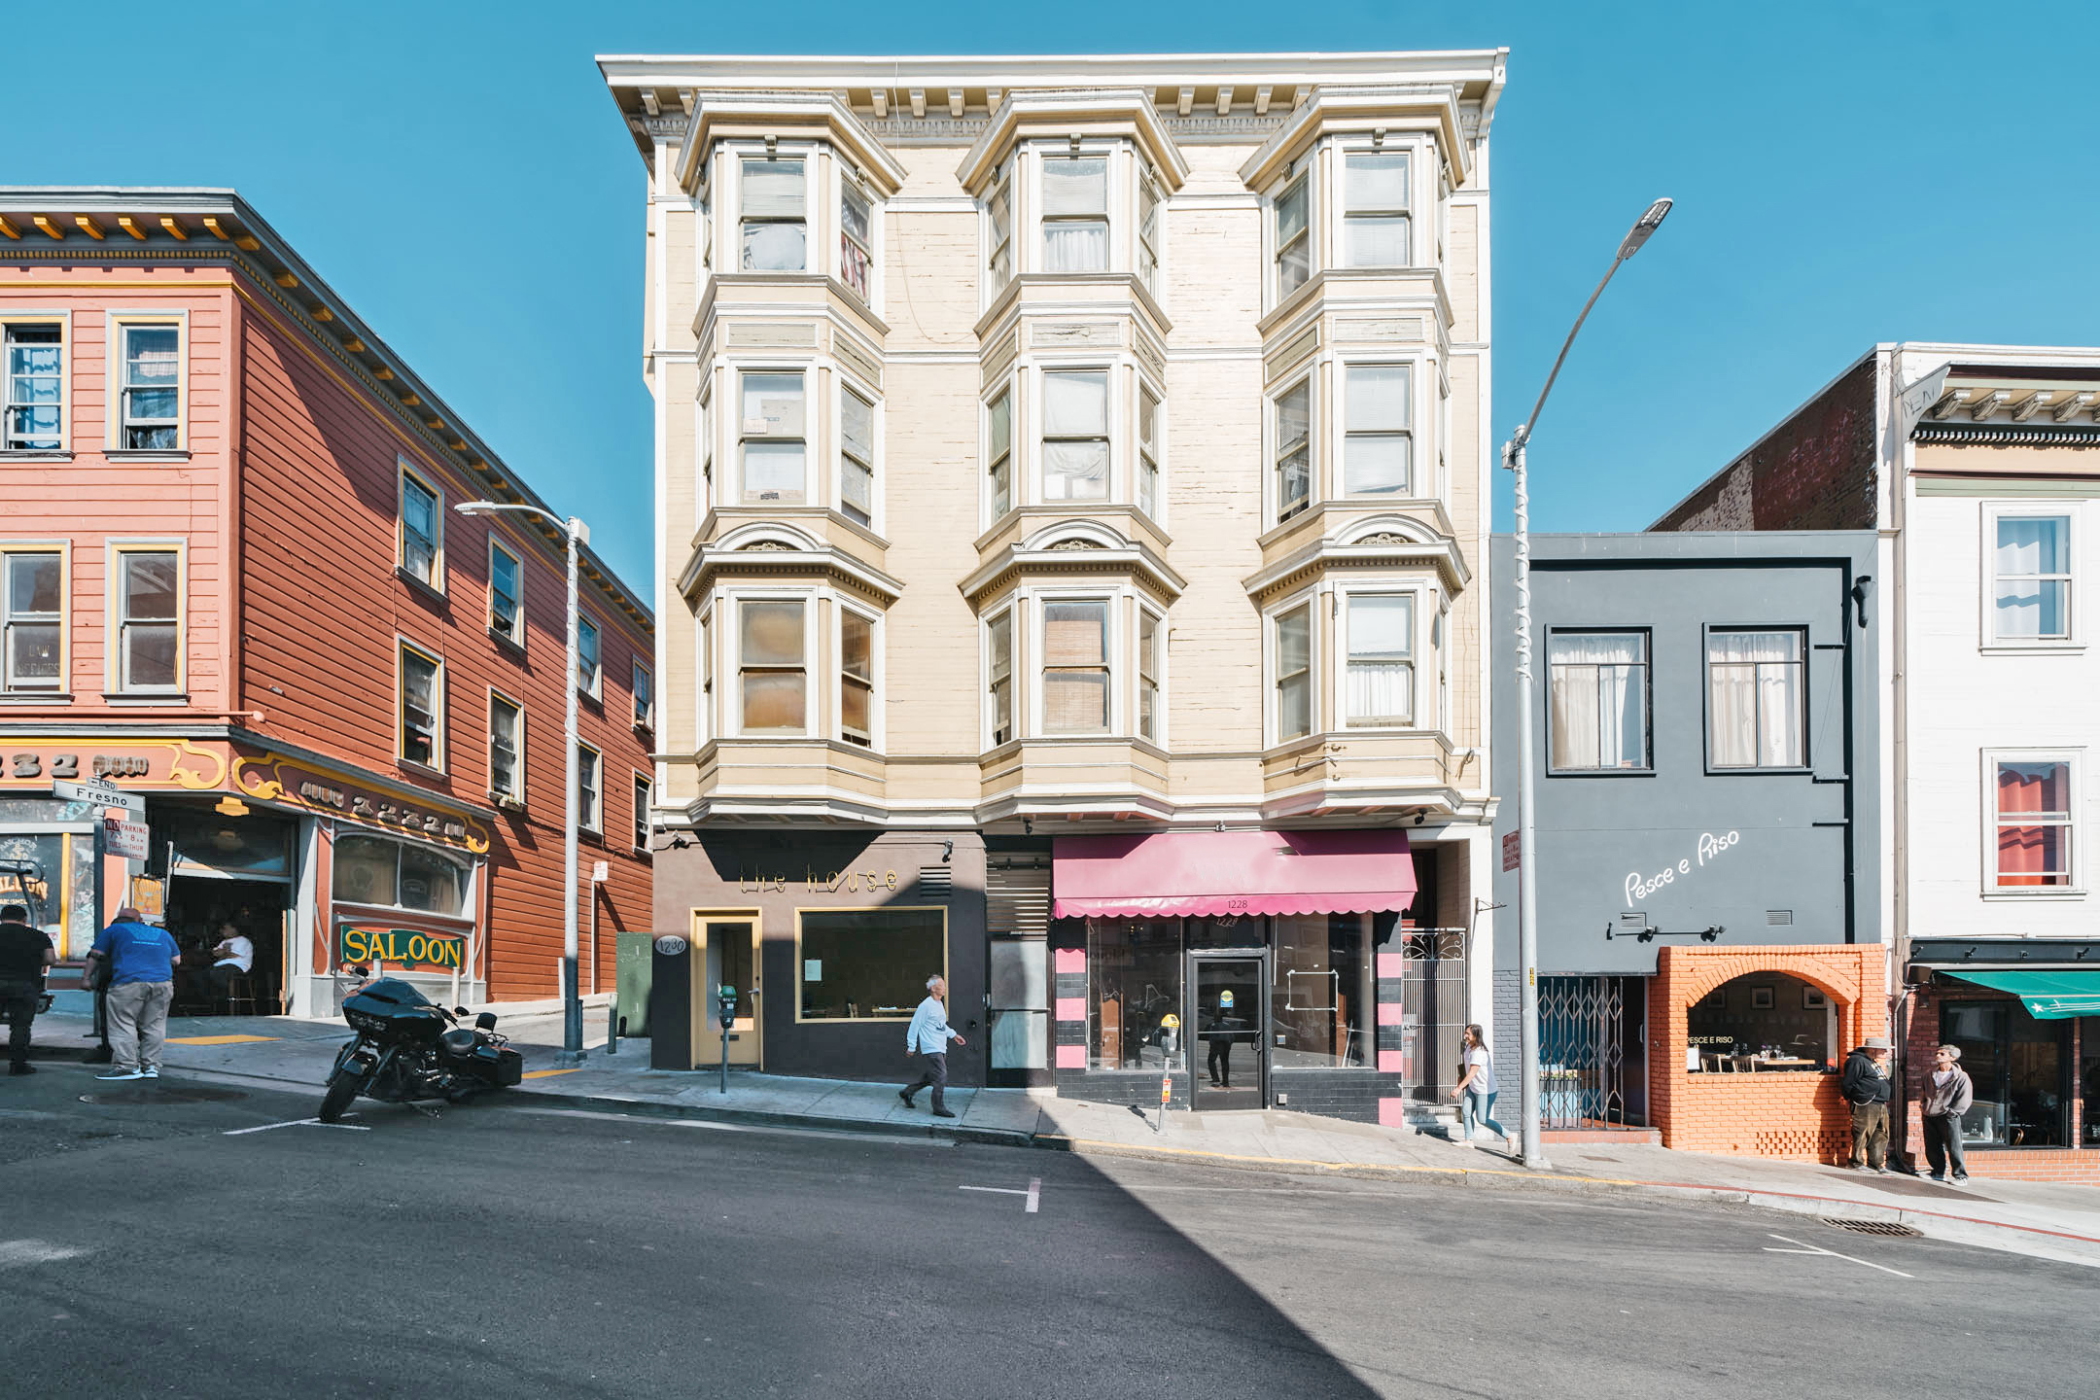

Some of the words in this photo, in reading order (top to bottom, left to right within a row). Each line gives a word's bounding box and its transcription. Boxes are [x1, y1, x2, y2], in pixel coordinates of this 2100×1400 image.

[98, 780, 116, 790] END
[76, 787, 128, 806] Fresno
[107, 819, 119, 831] NO
[120, 823, 147, 836] PARKING
[1624, 872, 1675, 908] Pesce
[1678, 858, 1690, 875] e
[1697, 830, 1740, 867] Riso
[739, 863, 786, 892] the
[807, 863, 897, 893] house
[1227, 900, 1248, 909] 1228
[345, 930, 461, 968] SALOON
[659, 937, 685, 954] 1230
[1710, 1036, 1715, 1044] E
[1716, 1036, 1734, 1044] RISO
